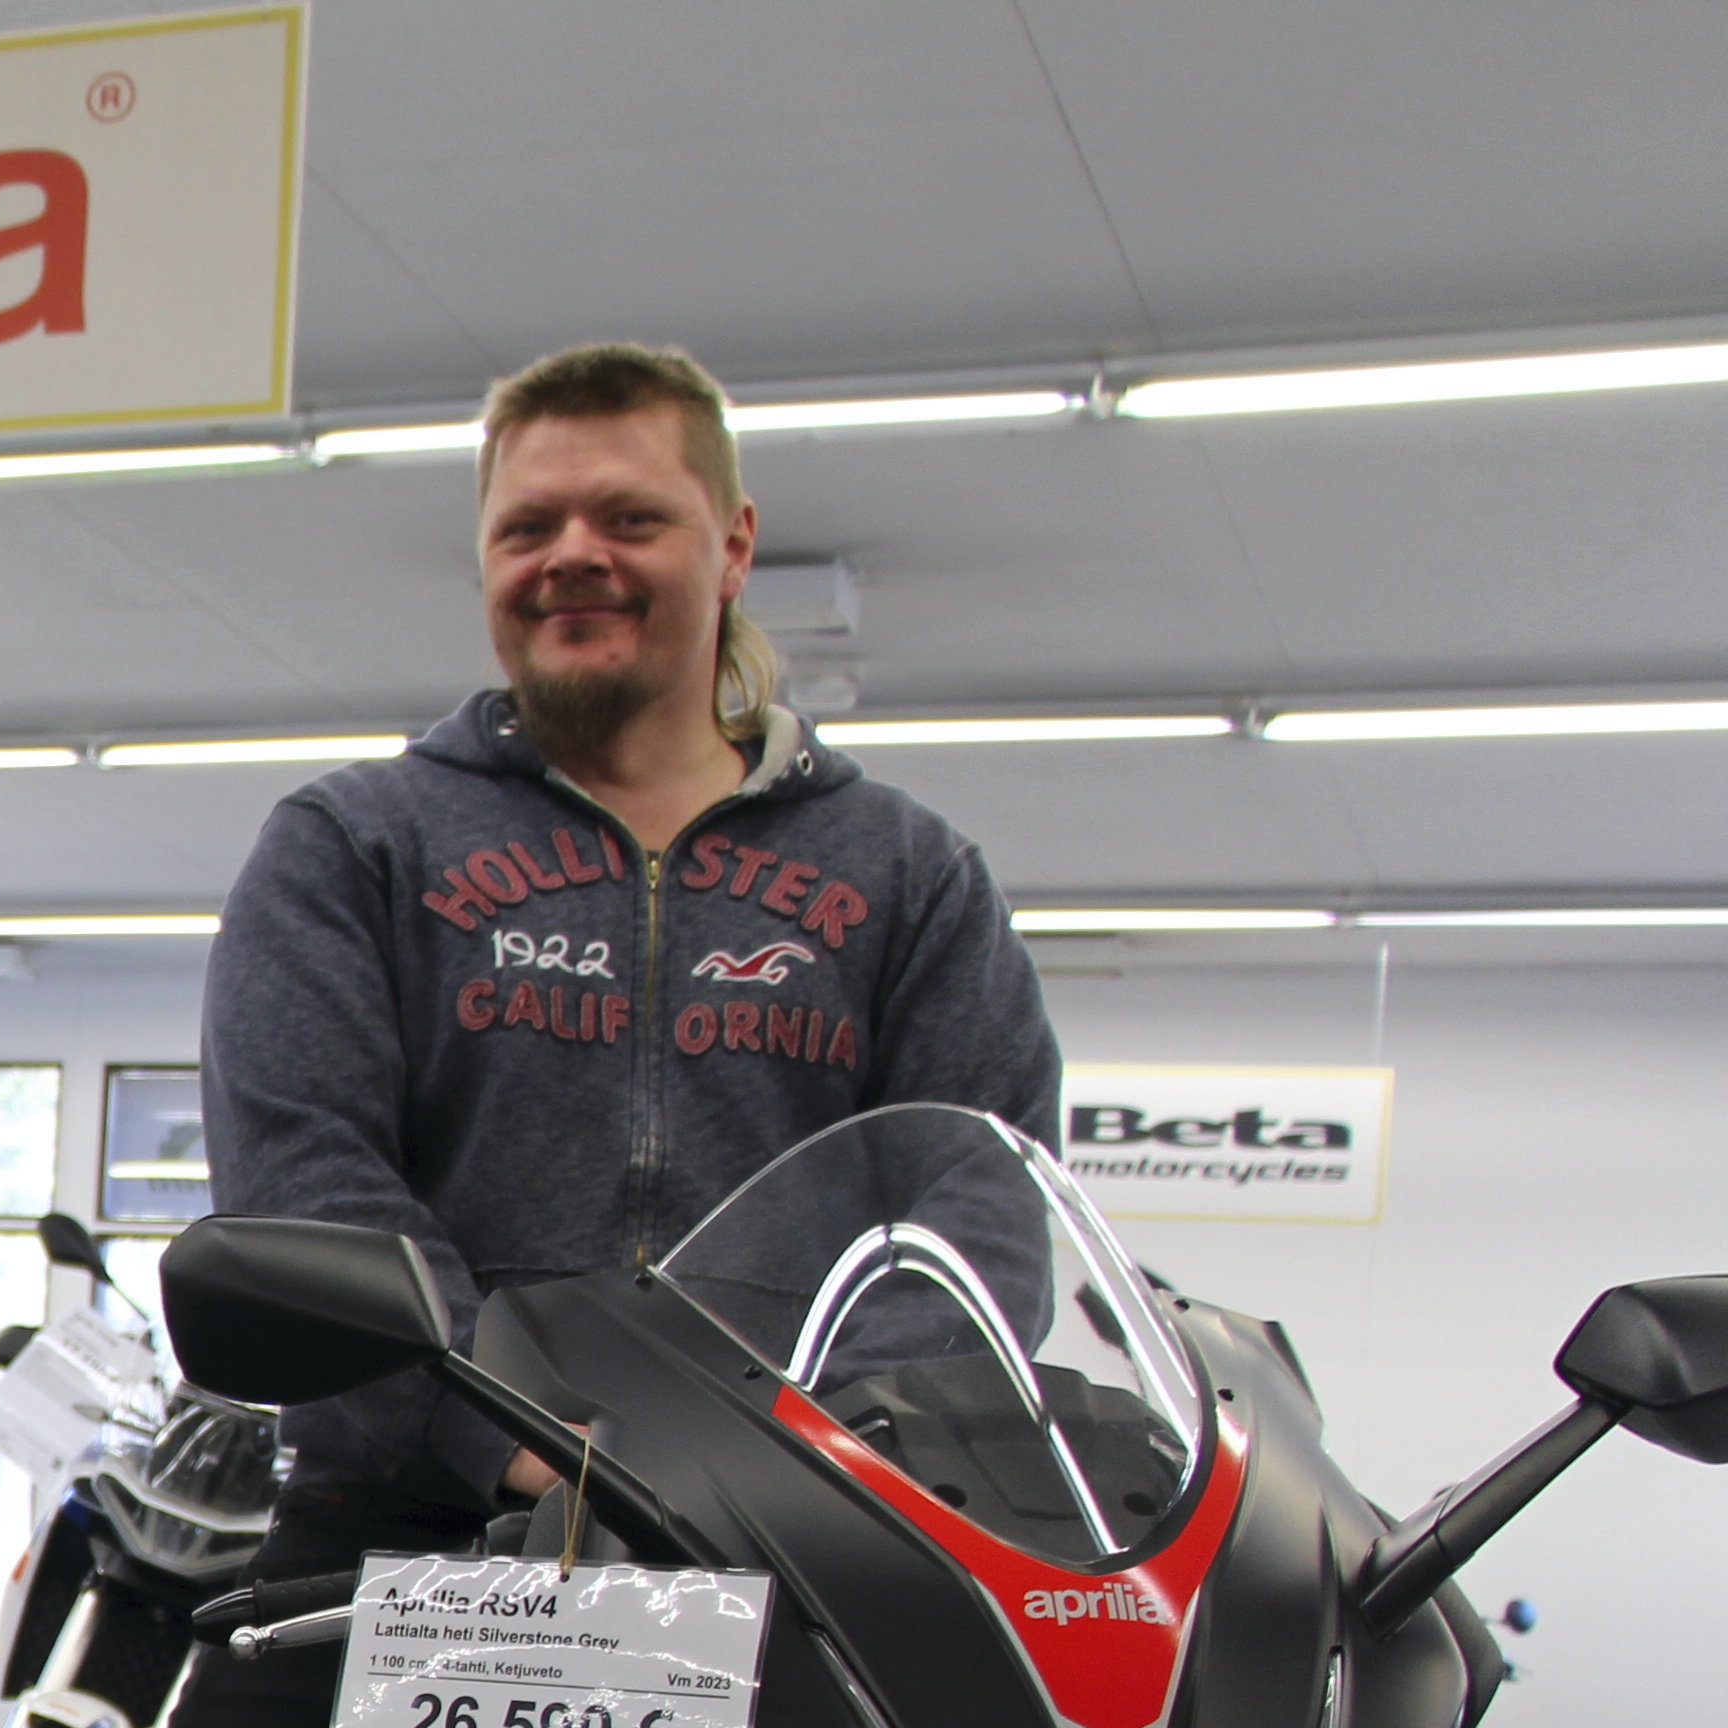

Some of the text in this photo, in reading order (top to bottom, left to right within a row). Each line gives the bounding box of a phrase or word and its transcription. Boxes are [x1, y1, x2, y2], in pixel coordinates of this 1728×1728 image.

[491, 930, 615, 980] 1922
[1069, 1104, 1352, 1150] Beta
[1068, 1156, 1349, 1188] motorcycles
[378, 1587, 558, 1619] Aprilia RSV4
[1023, 1583, 1169, 1625] aprilia
[374, 1621, 439, 1640] Lattialta
[443, 1625, 474, 1641] heti
[477, 1626, 574, 1647] Silverstone
[381, 1654, 406, 1669] 100
[494, 1661, 563, 1679] Ketjuveto
[667, 1672, 731, 1690] Vm 2023
